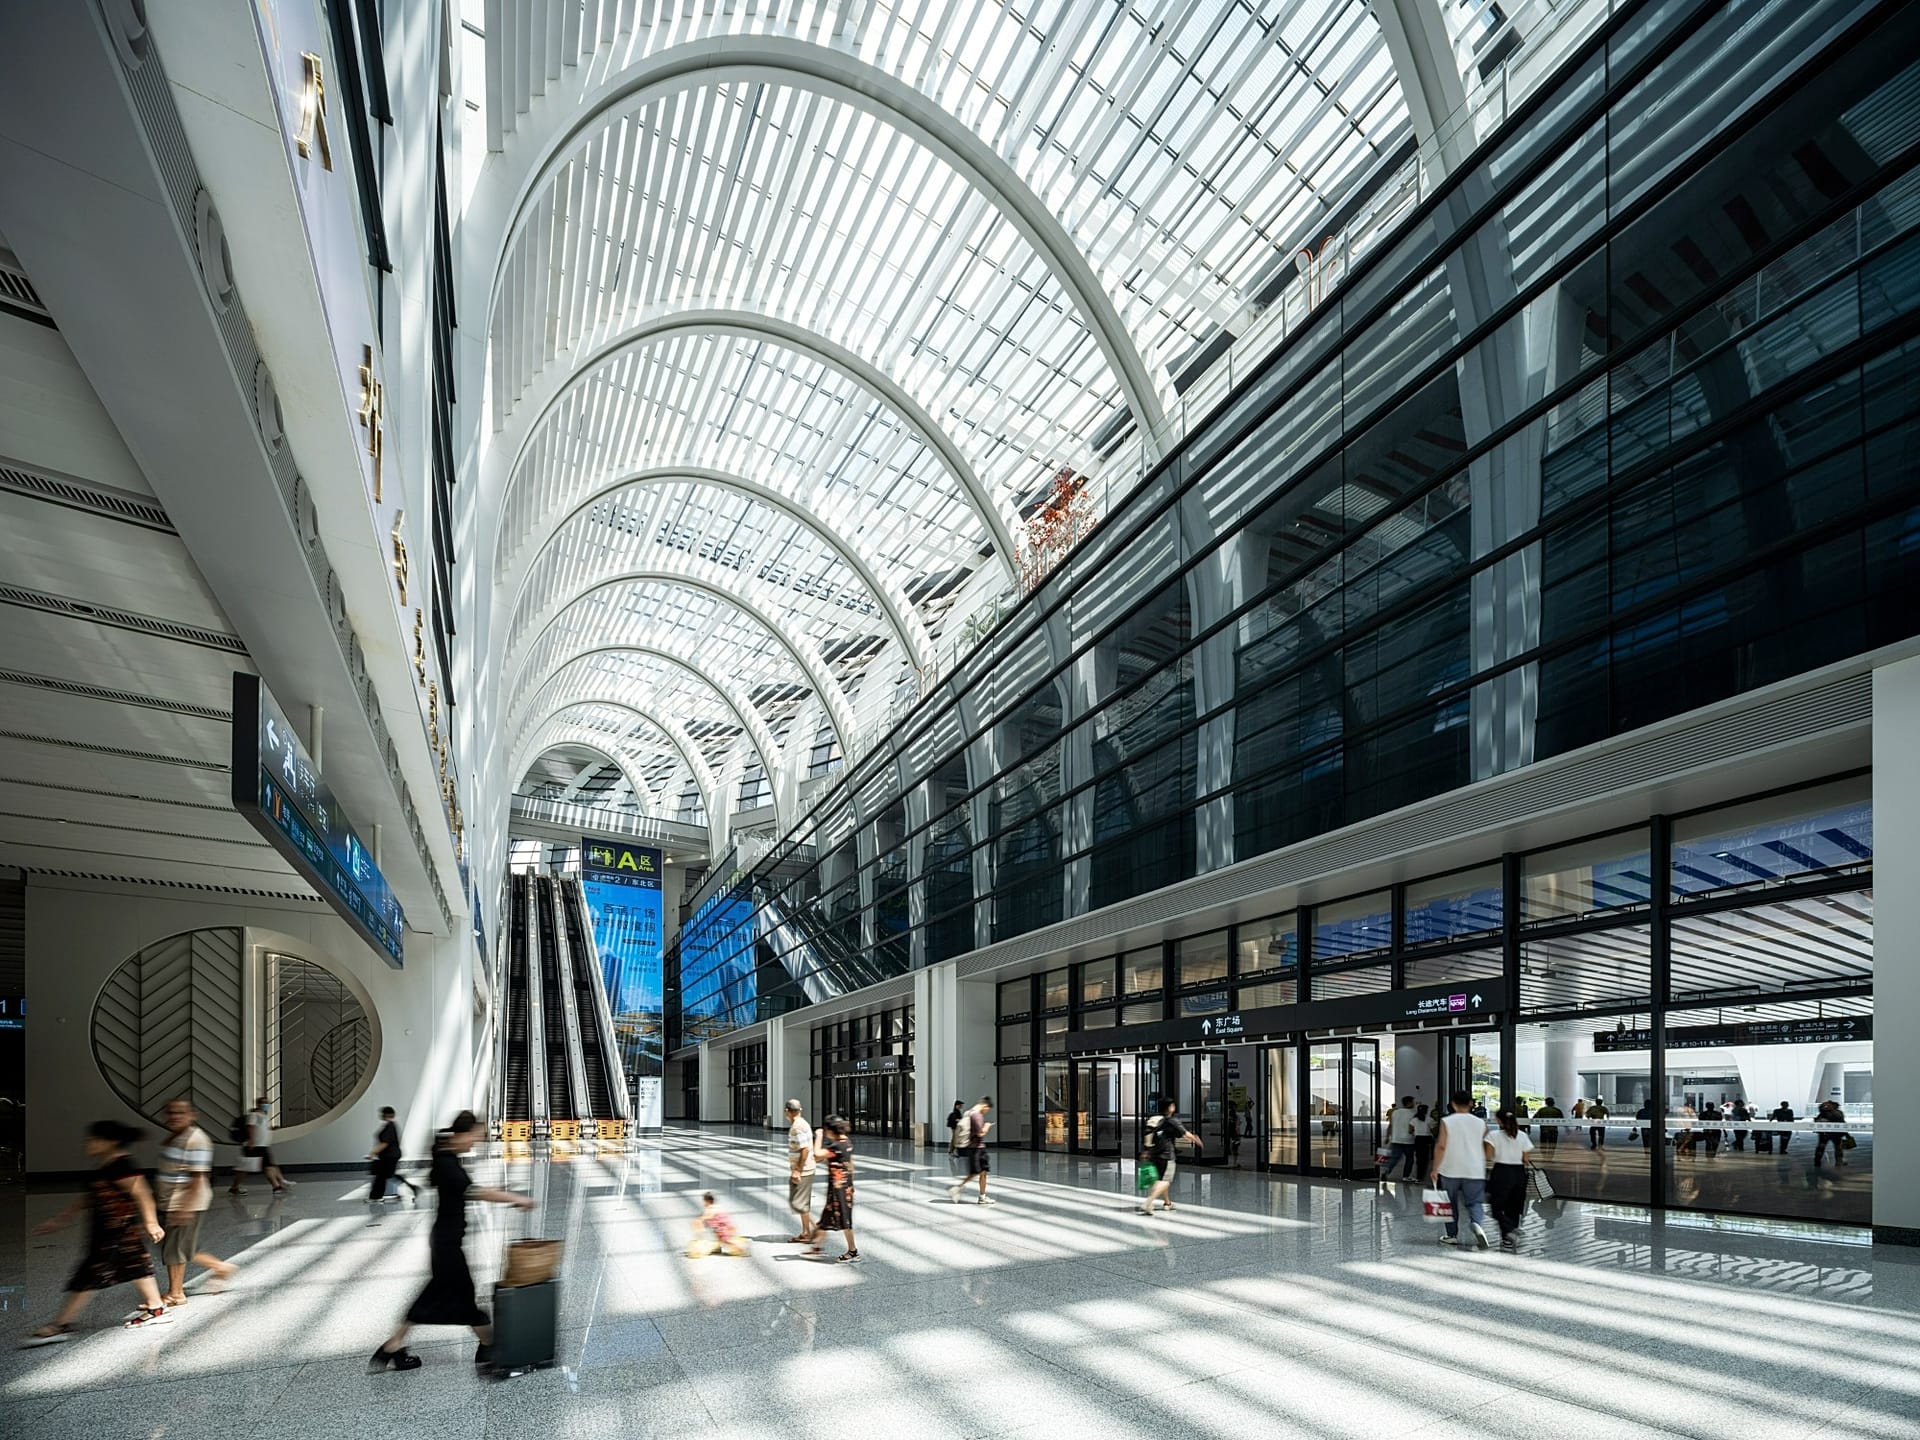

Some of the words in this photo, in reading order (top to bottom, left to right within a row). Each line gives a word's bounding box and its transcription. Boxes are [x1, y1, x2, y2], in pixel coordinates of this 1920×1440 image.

[616, 851, 638, 871] A
[640, 855, 652, 866] 区
[638, 864, 655, 872] Area
[1417, 998, 1448, 1008] 长途汽车
[1215, 1015, 1241, 1028] 东广场
[1226, 1026, 1243, 1034] Square
